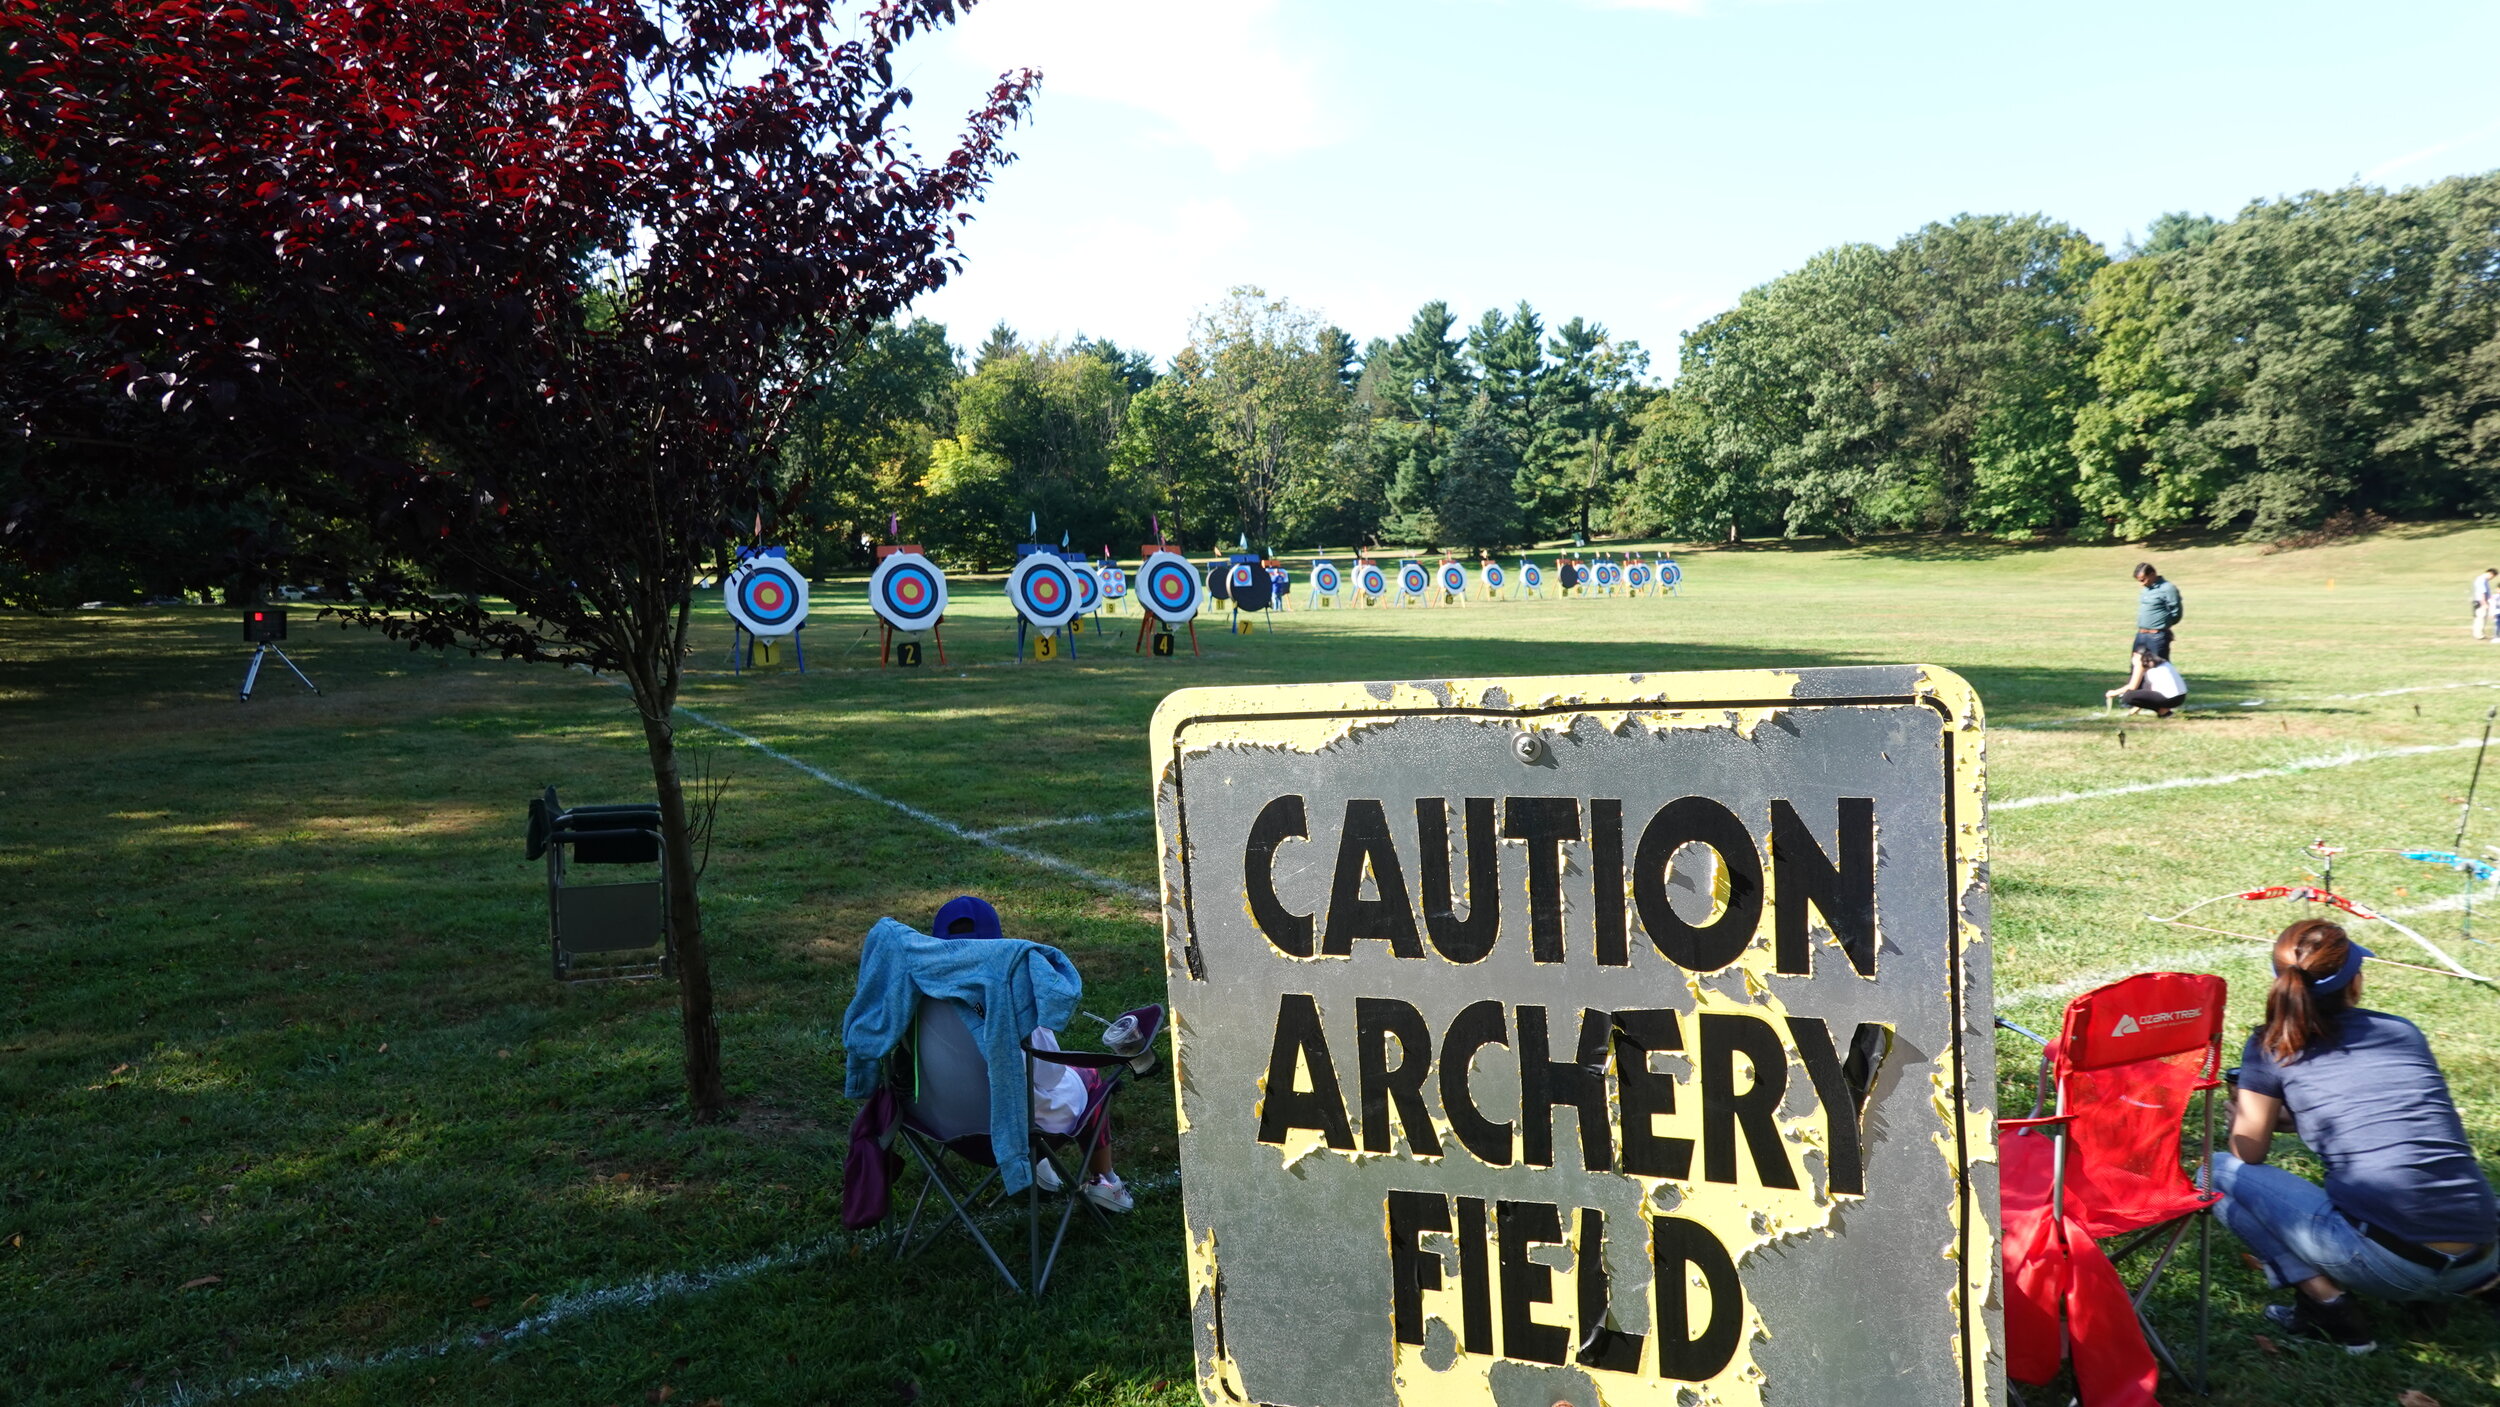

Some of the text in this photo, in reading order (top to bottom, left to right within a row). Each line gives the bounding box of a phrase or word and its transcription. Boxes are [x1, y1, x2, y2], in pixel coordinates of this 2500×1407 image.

[1072, 620, 1080, 632] 5
[1243, 622, 1249, 634] 7
[904, 644, 916, 665] 2
[1041, 637, 1051, 656] 3
[1159, 635, 1168, 654] 4
[1243, 794, 1876, 978] CAUTION
[1256, 992, 1896, 1196] ARCHERY
[1386, 1189, 1743, 1382] FIELD
